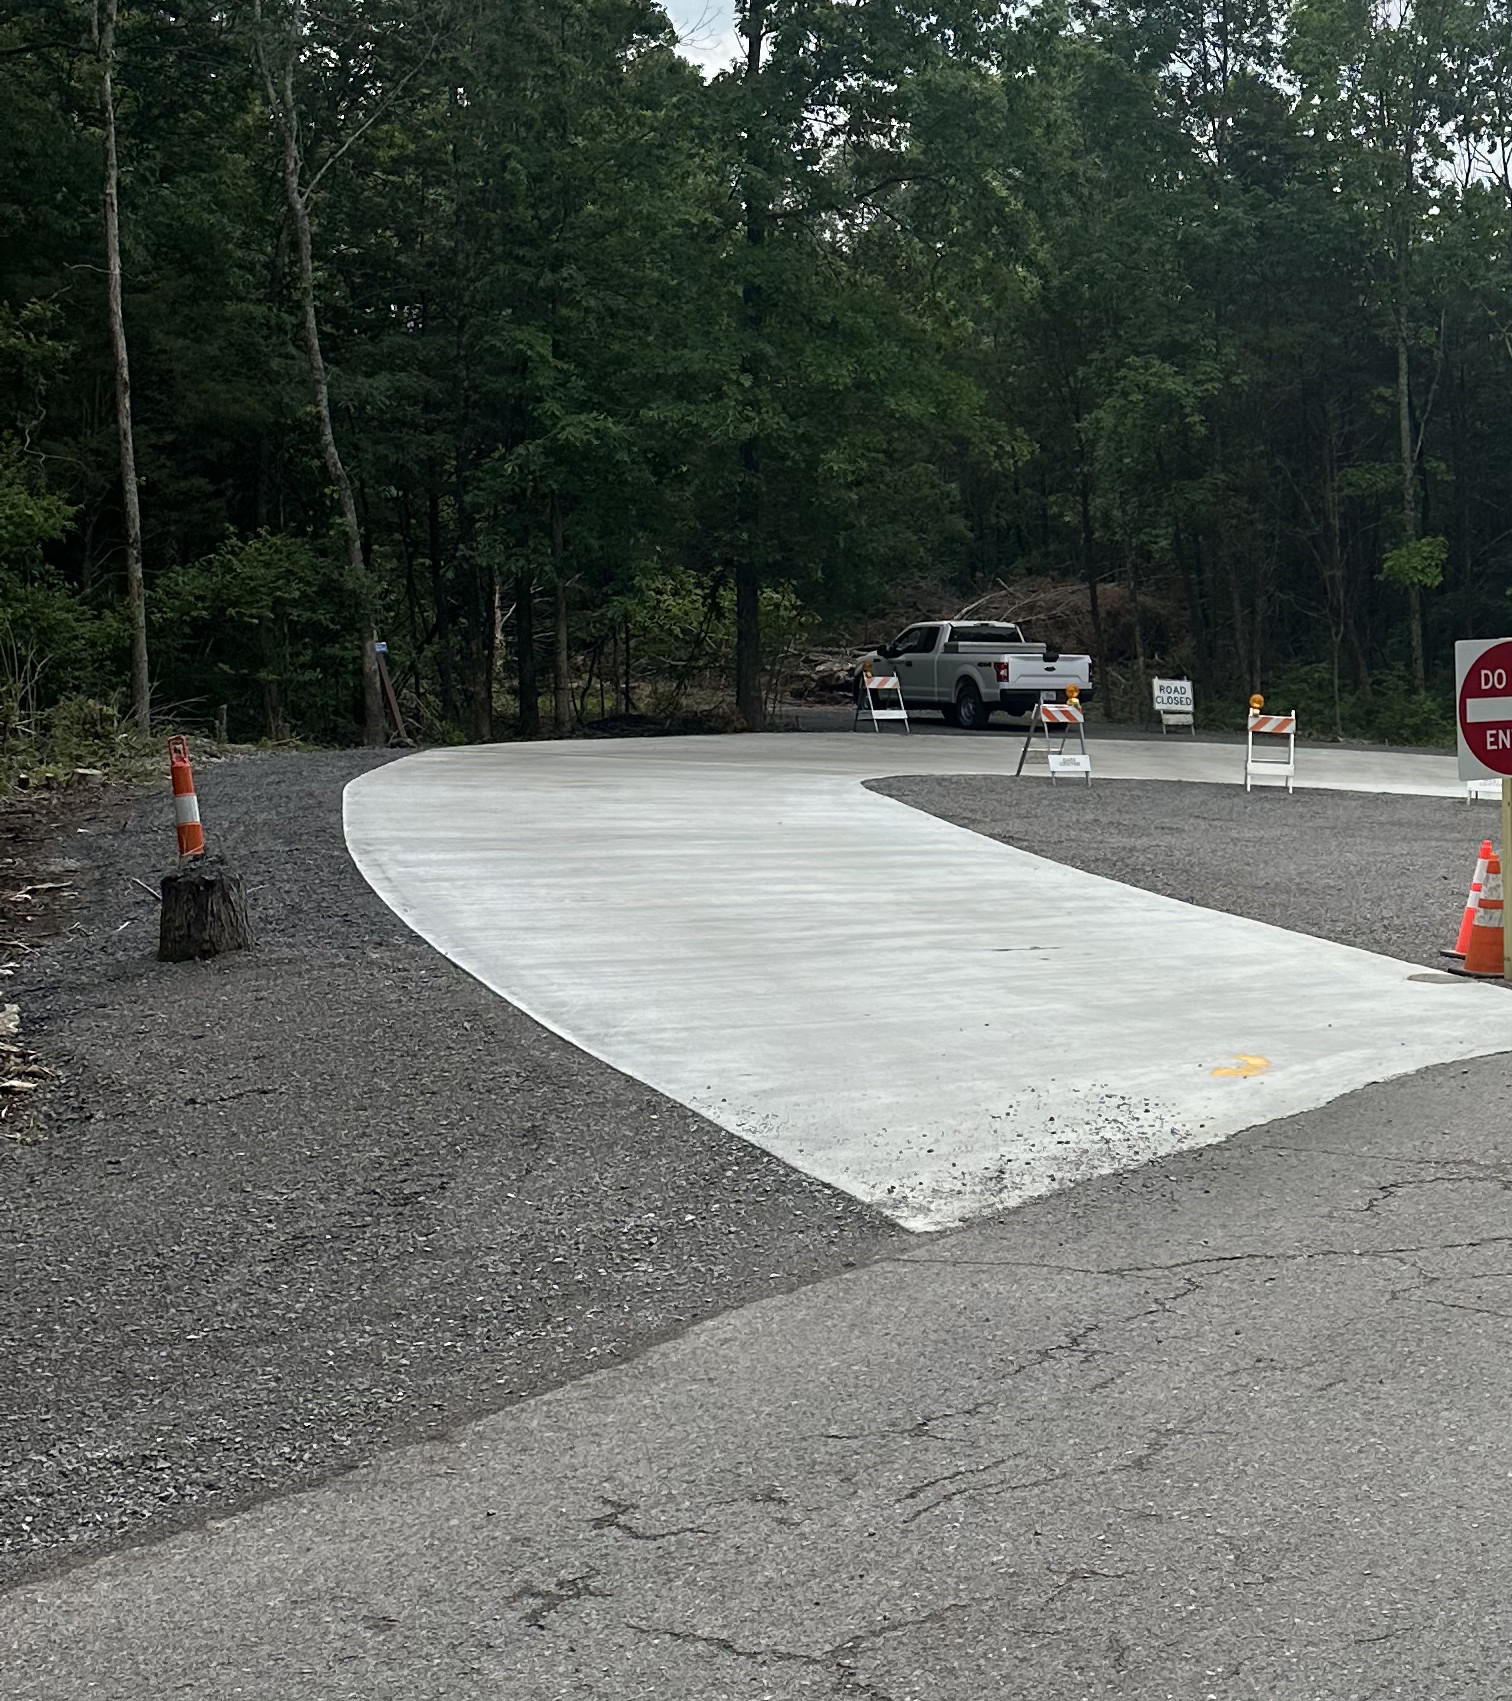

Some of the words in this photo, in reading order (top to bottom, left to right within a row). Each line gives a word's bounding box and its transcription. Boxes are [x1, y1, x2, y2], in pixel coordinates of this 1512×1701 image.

[1481, 669, 1506, 690] DO
[1159, 685, 1187, 695] ROAD
[1155, 695, 1192, 706] CLOSED
